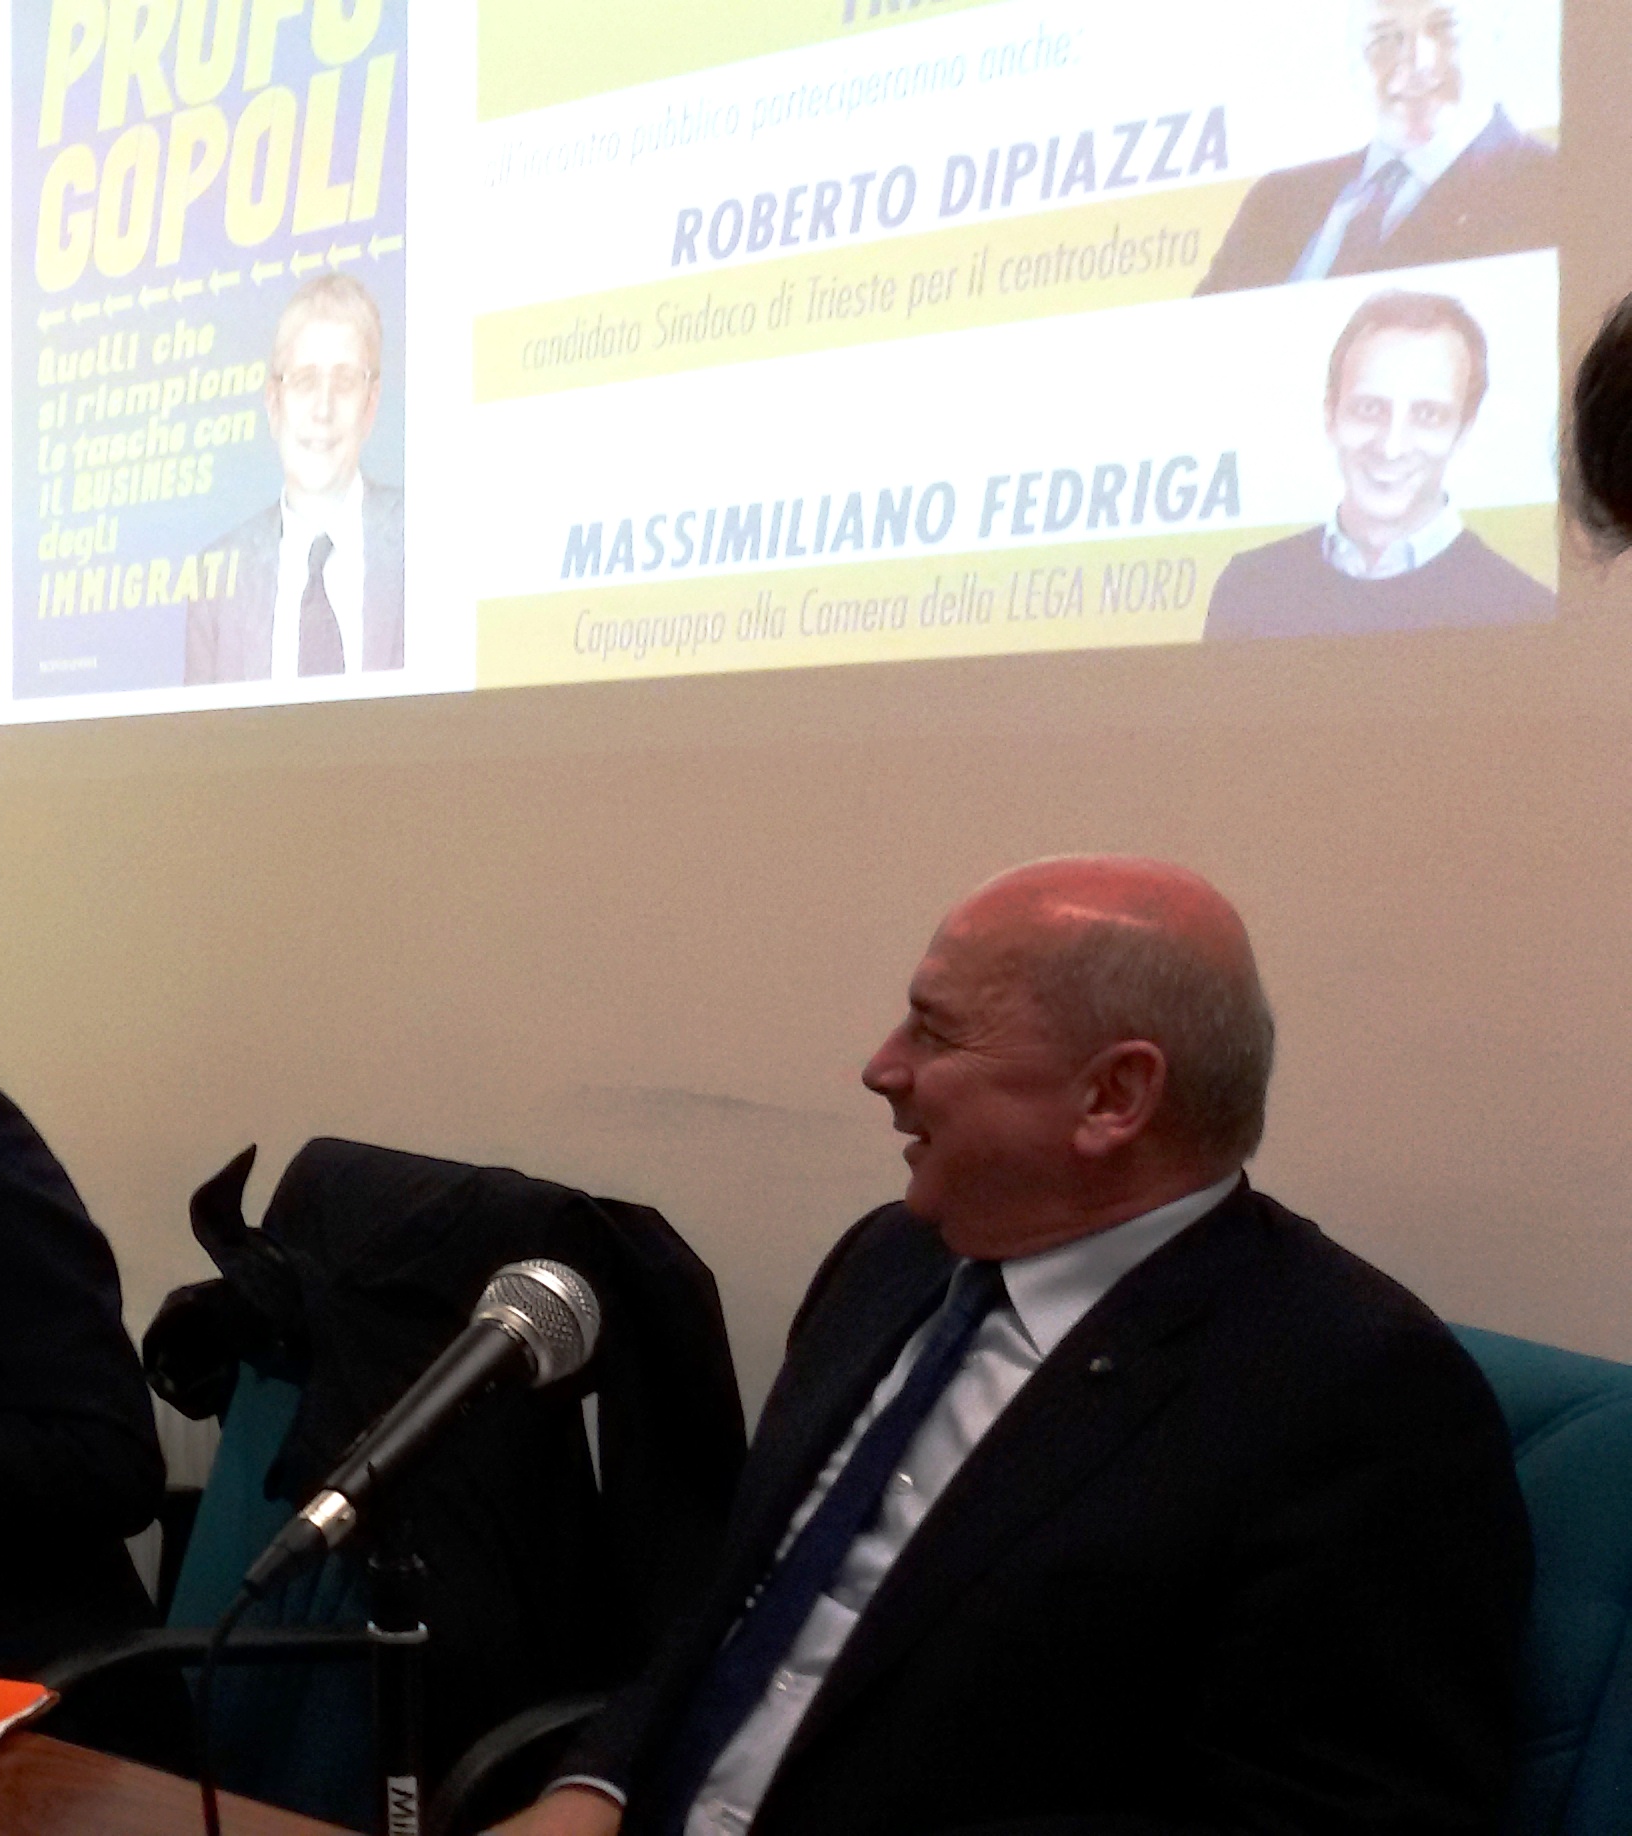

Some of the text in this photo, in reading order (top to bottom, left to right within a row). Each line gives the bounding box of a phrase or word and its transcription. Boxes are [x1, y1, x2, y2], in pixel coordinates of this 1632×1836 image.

[632, 102, 742, 161] pubblico
[750, 51, 969, 140] parteciperanno
[34, 51, 397, 293] GOPOLI
[670, 105, 1229, 268] ROBERTO DIPIAZZA
[521, 223, 1200, 372] candidato Sindaco di Trieste per il centrodestra
[37, 319, 217, 388] Quelli che
[38, 360, 267, 431] si riempiono
[37, 409, 258, 475] le tasche con
[39, 453, 215, 519] il BUSINESS
[37, 514, 120, 566] degli
[560, 450, 1244, 581] MASSIMILIANO FEDRIGA
[38, 548, 241, 619] IMMIGRATI
[574, 557, 1198, 662] Capogruppo alla Camera della LEGA NORD
